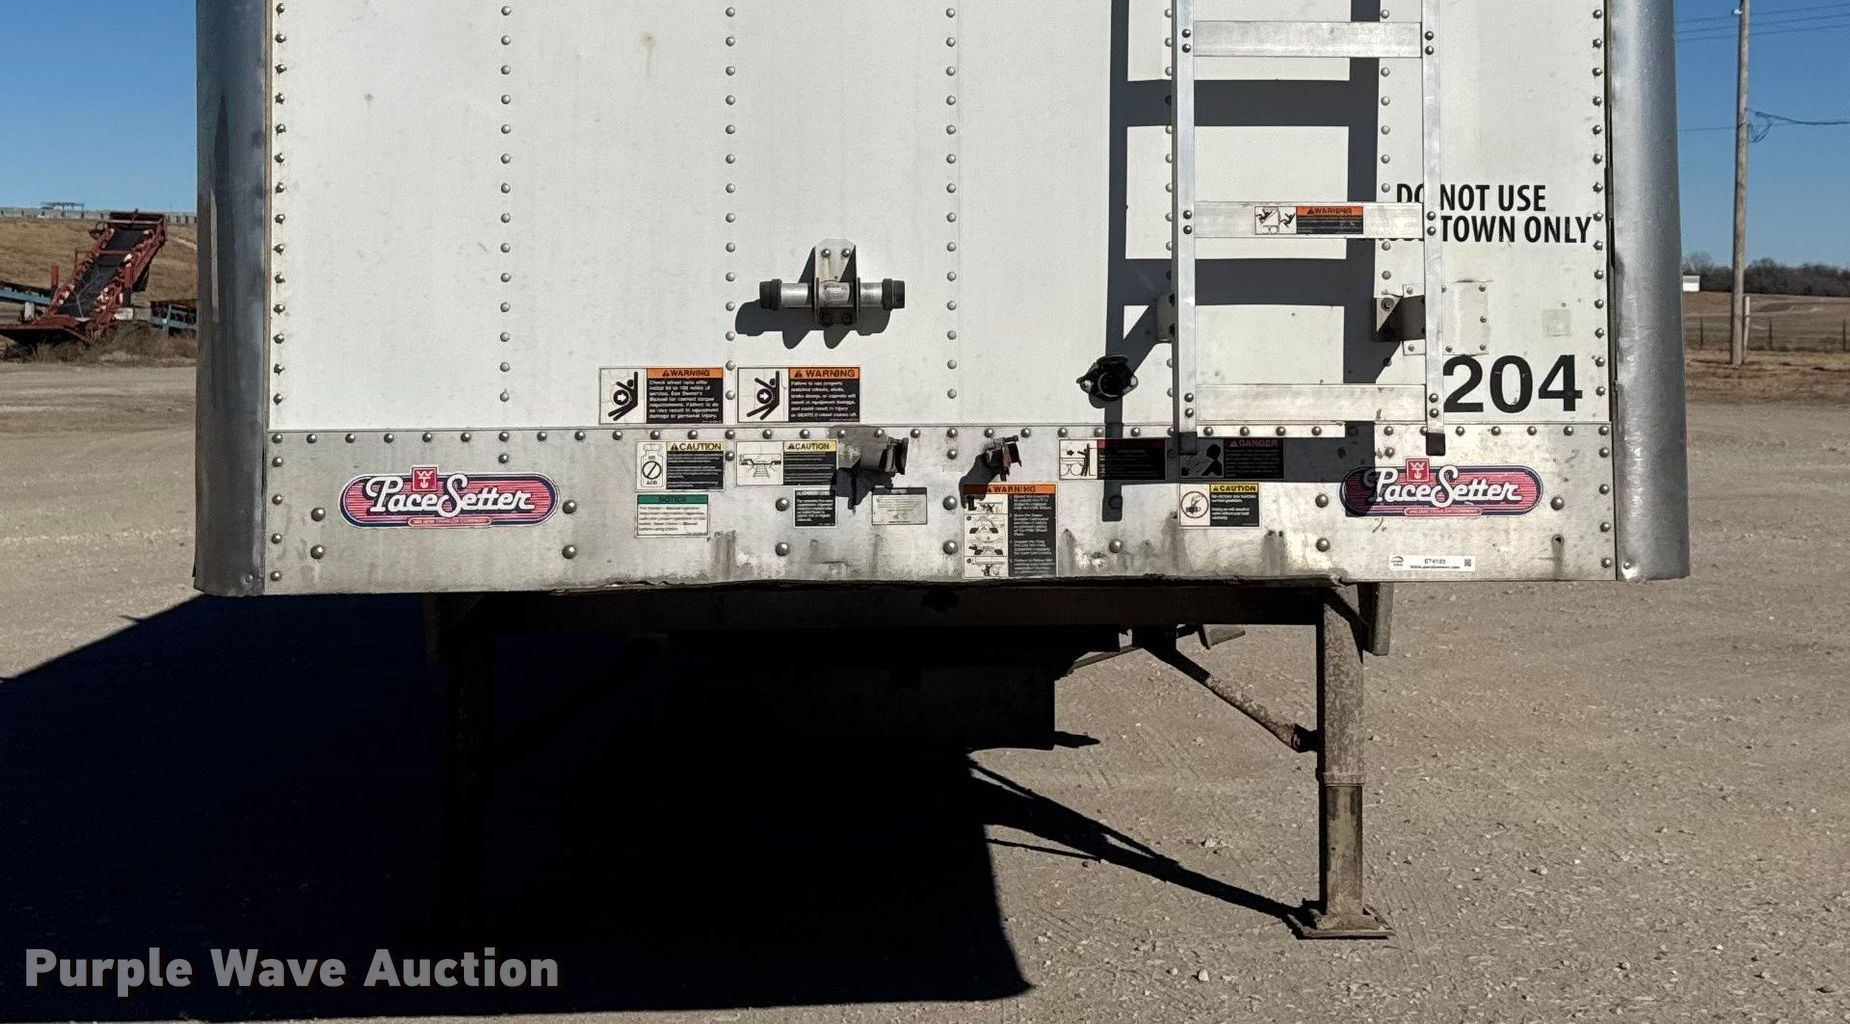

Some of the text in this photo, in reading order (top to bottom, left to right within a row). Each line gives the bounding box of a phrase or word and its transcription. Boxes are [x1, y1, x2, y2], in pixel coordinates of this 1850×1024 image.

[1440, 184, 1490, 211] NOT
[1498, 185, 1546, 211] USE
[1440, 215, 1592, 243] TOWN ONLY
[670, 369, 710, 377] WARNING
[805, 369, 856, 377] WARNING
[1443, 354, 1583, 413] 204
[1238, 439, 1278, 447] DANGER
[365, 474, 536, 518] PaceSetter
[1363, 465, 1523, 508] PaceSetter
